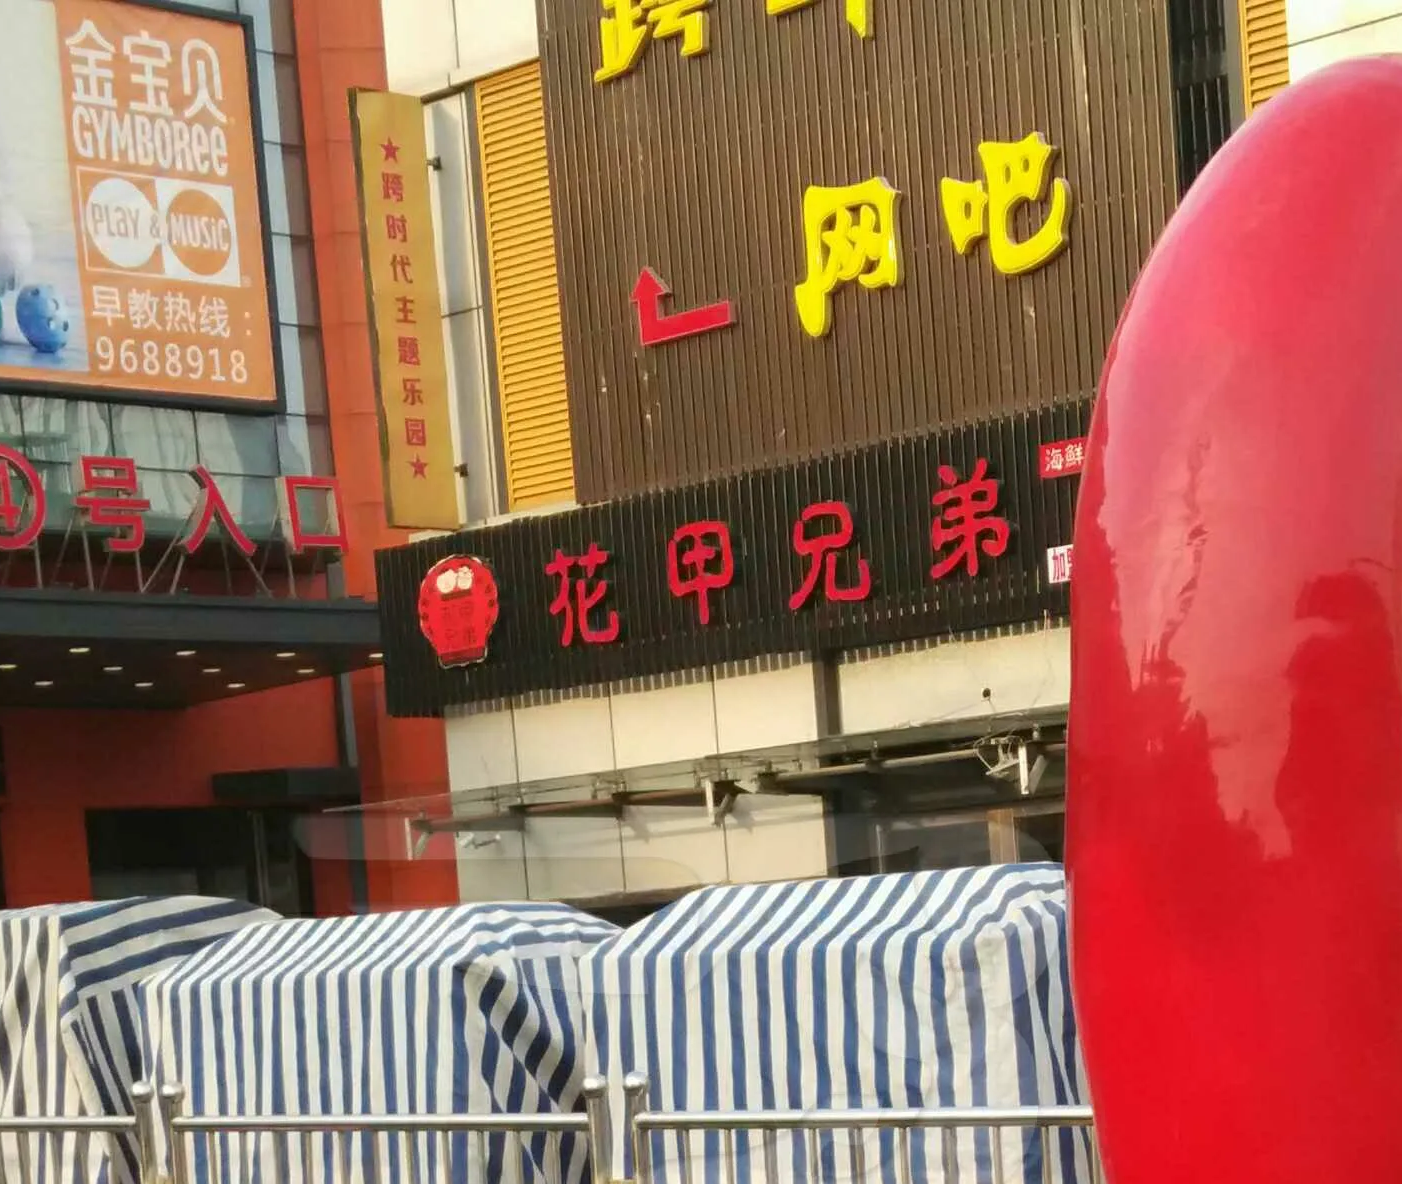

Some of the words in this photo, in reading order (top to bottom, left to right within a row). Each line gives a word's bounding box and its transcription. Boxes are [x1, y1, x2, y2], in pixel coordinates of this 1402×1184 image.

[65, 18, 228, 125] 金宝贝
[381, 171, 427, 448] 跨时代主题乐园
[795, 130, 1073, 338] 网吧
[96, 335, 248, 384] 9688918
[547, 456, 1012, 648] 花甲兄弟
